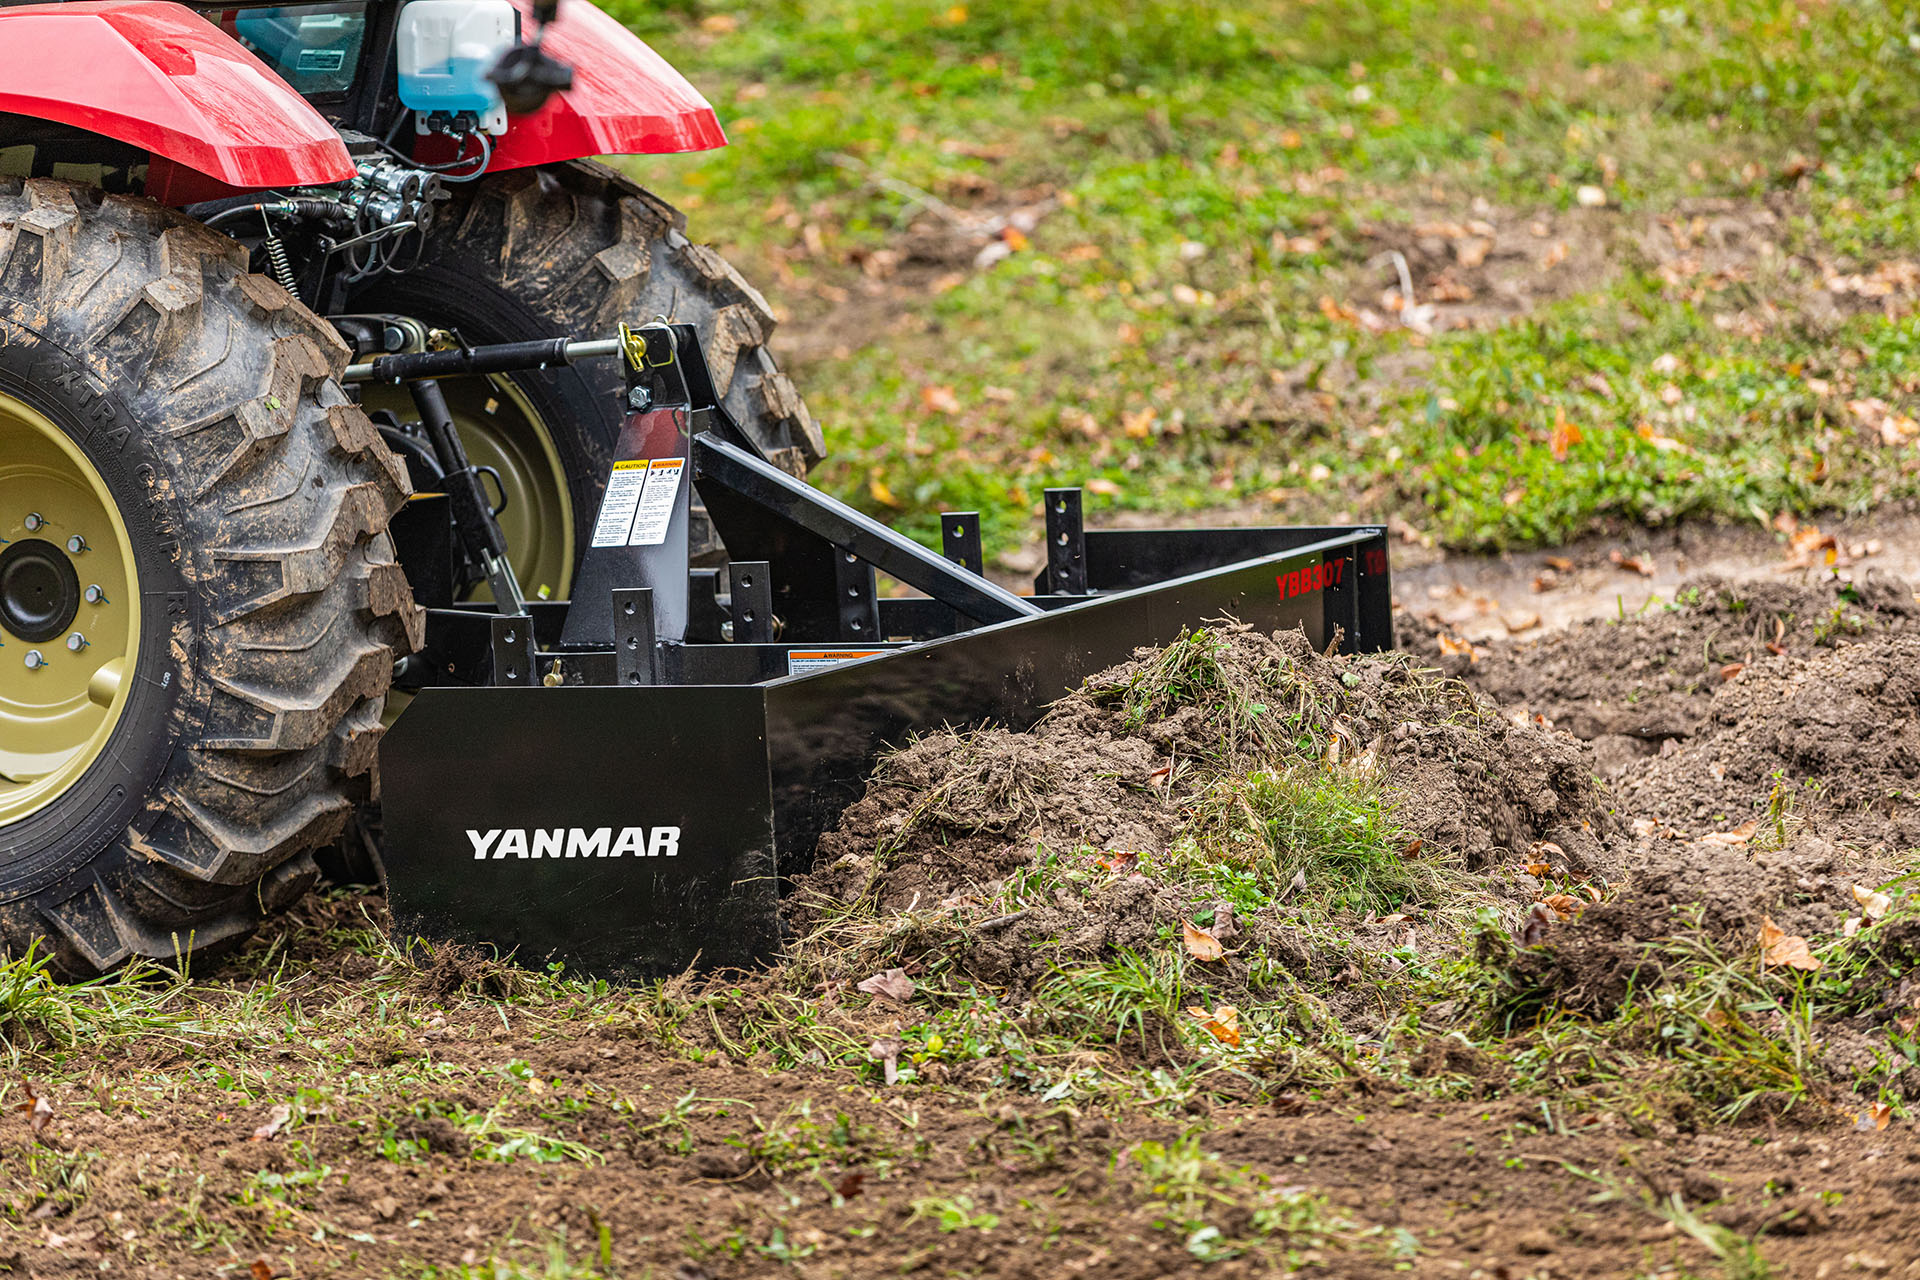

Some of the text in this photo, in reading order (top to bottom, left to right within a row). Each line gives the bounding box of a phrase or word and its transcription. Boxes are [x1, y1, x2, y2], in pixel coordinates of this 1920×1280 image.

[53, 362, 131, 453] XTRA
[1276, 558, 1345, 600] YBB307
[466, 826, 681, 860] YANMAR
